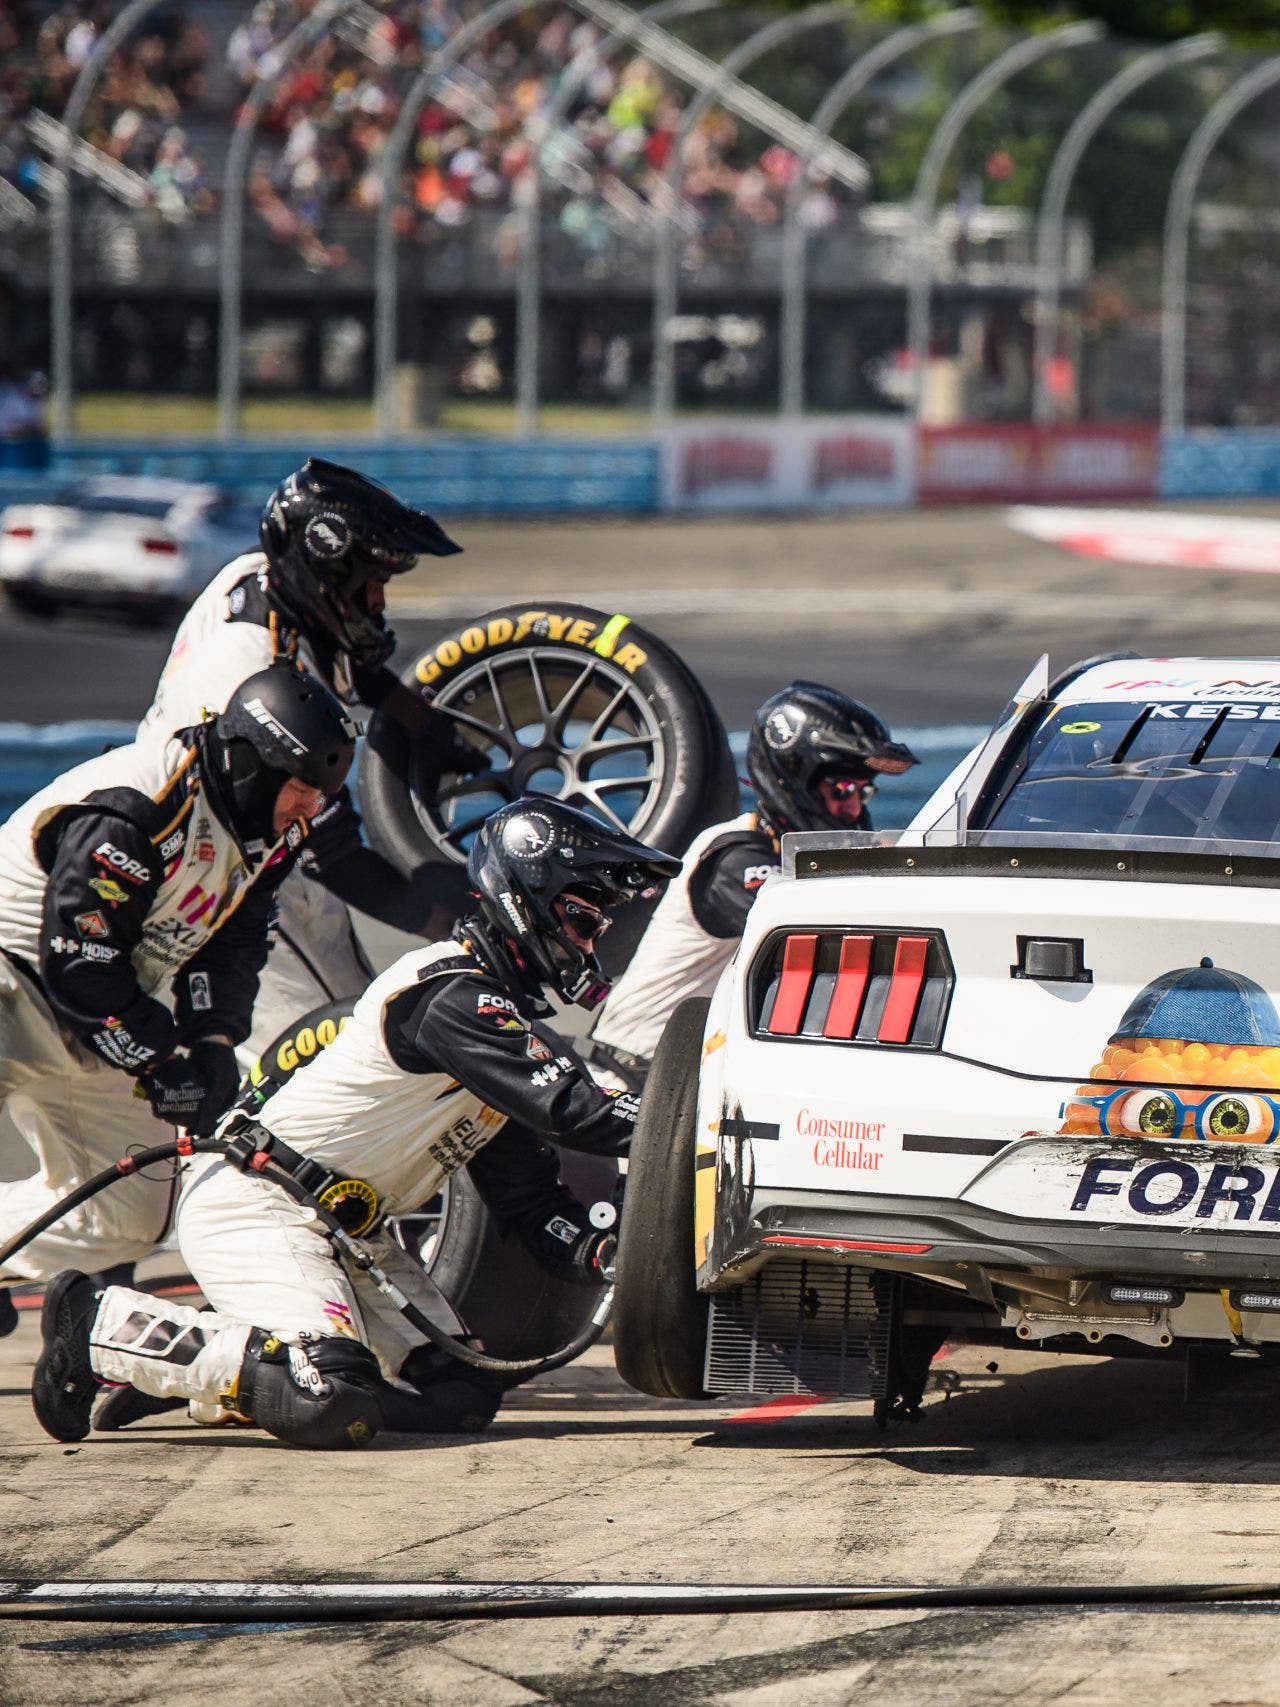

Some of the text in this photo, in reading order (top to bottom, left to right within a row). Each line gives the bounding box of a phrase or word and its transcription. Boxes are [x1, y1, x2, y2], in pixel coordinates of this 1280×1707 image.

[414, 610, 649, 685] GOODYER
[95, 841, 151, 882] FORD
[477, 993, 518, 1014] FOR
[796, 1107, 886, 1142] Consumer
[813, 1138, 884, 1171] Cellular
